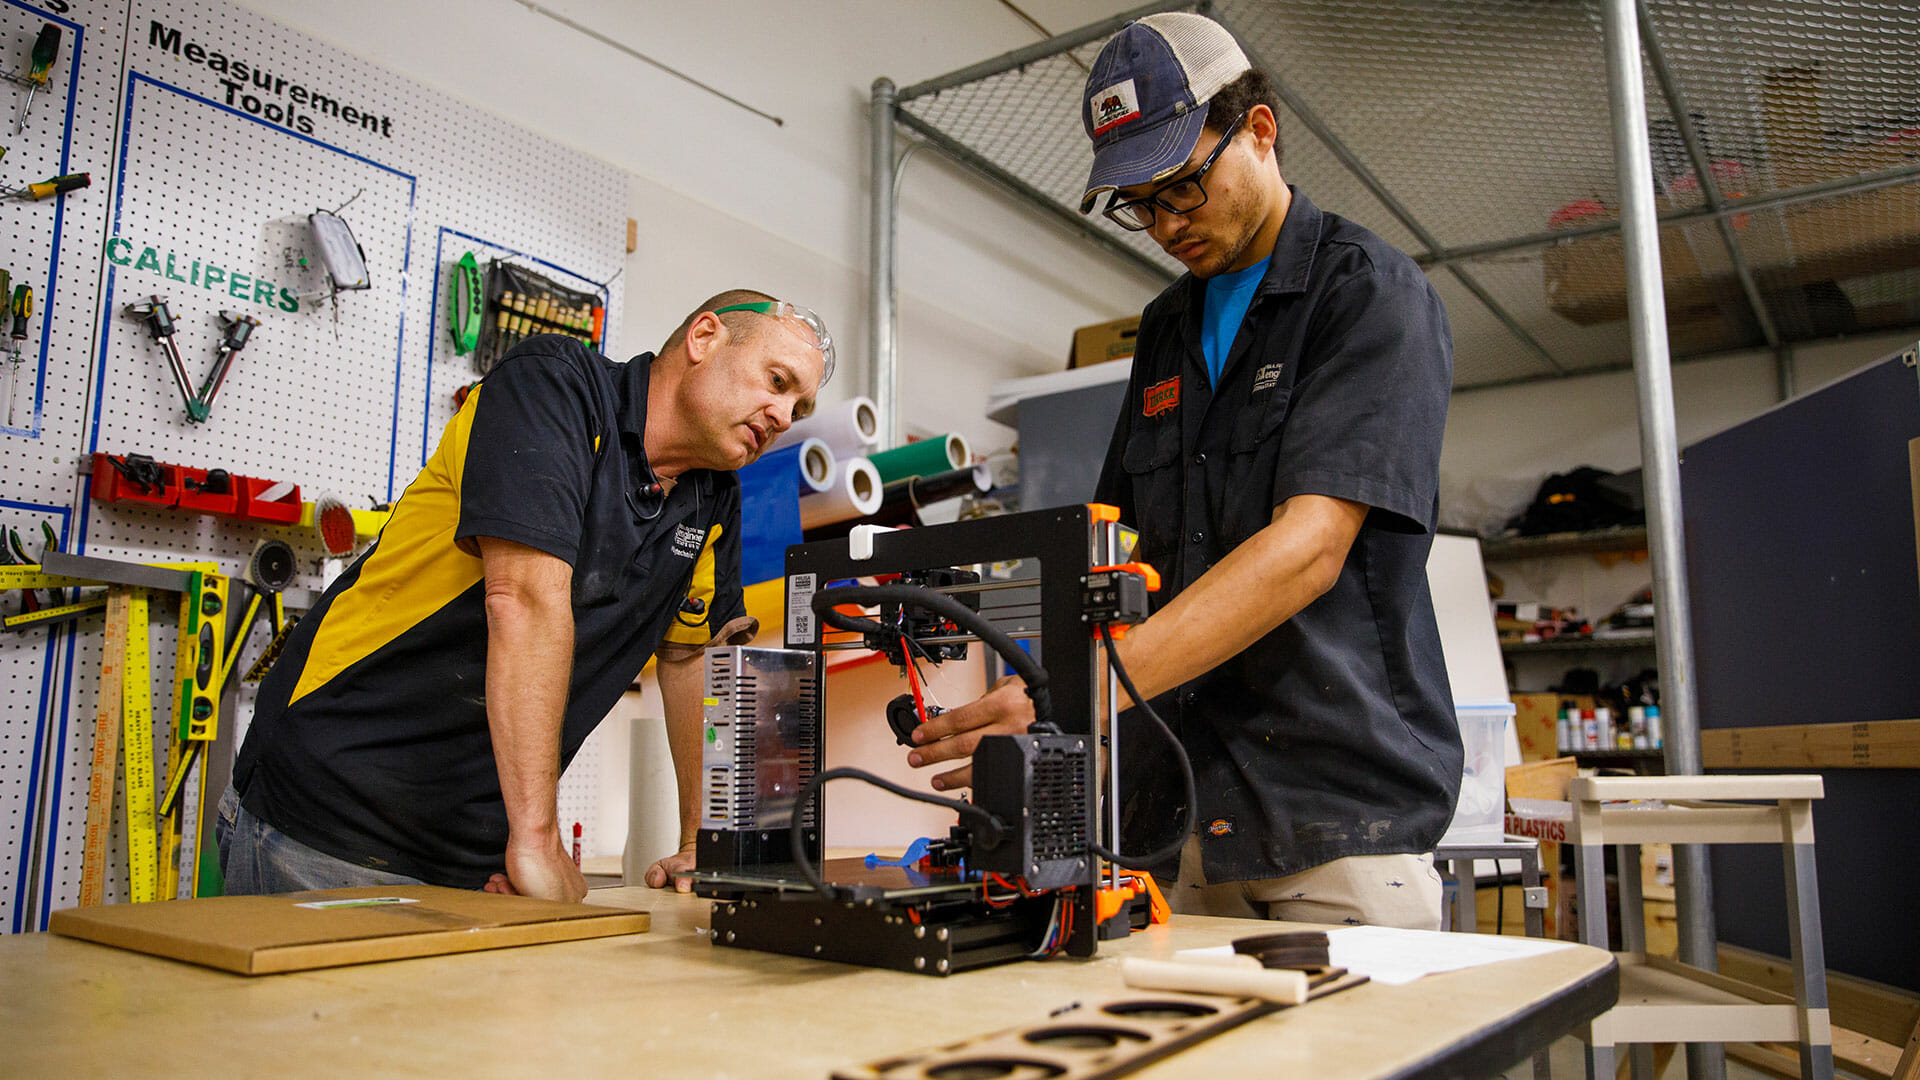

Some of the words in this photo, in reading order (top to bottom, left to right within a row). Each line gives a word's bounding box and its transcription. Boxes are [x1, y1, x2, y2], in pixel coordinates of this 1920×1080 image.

[149, 20, 392, 138] Measurement
[219, 77, 315, 134] Tools
[106, 237, 300, 313] CALIPERS
[98, 712, 108, 732] THE
[94, 739, 105, 768] HOME
[90, 773, 102, 804] DEPOT
[1513, 817, 1566, 841] PLASTICS
